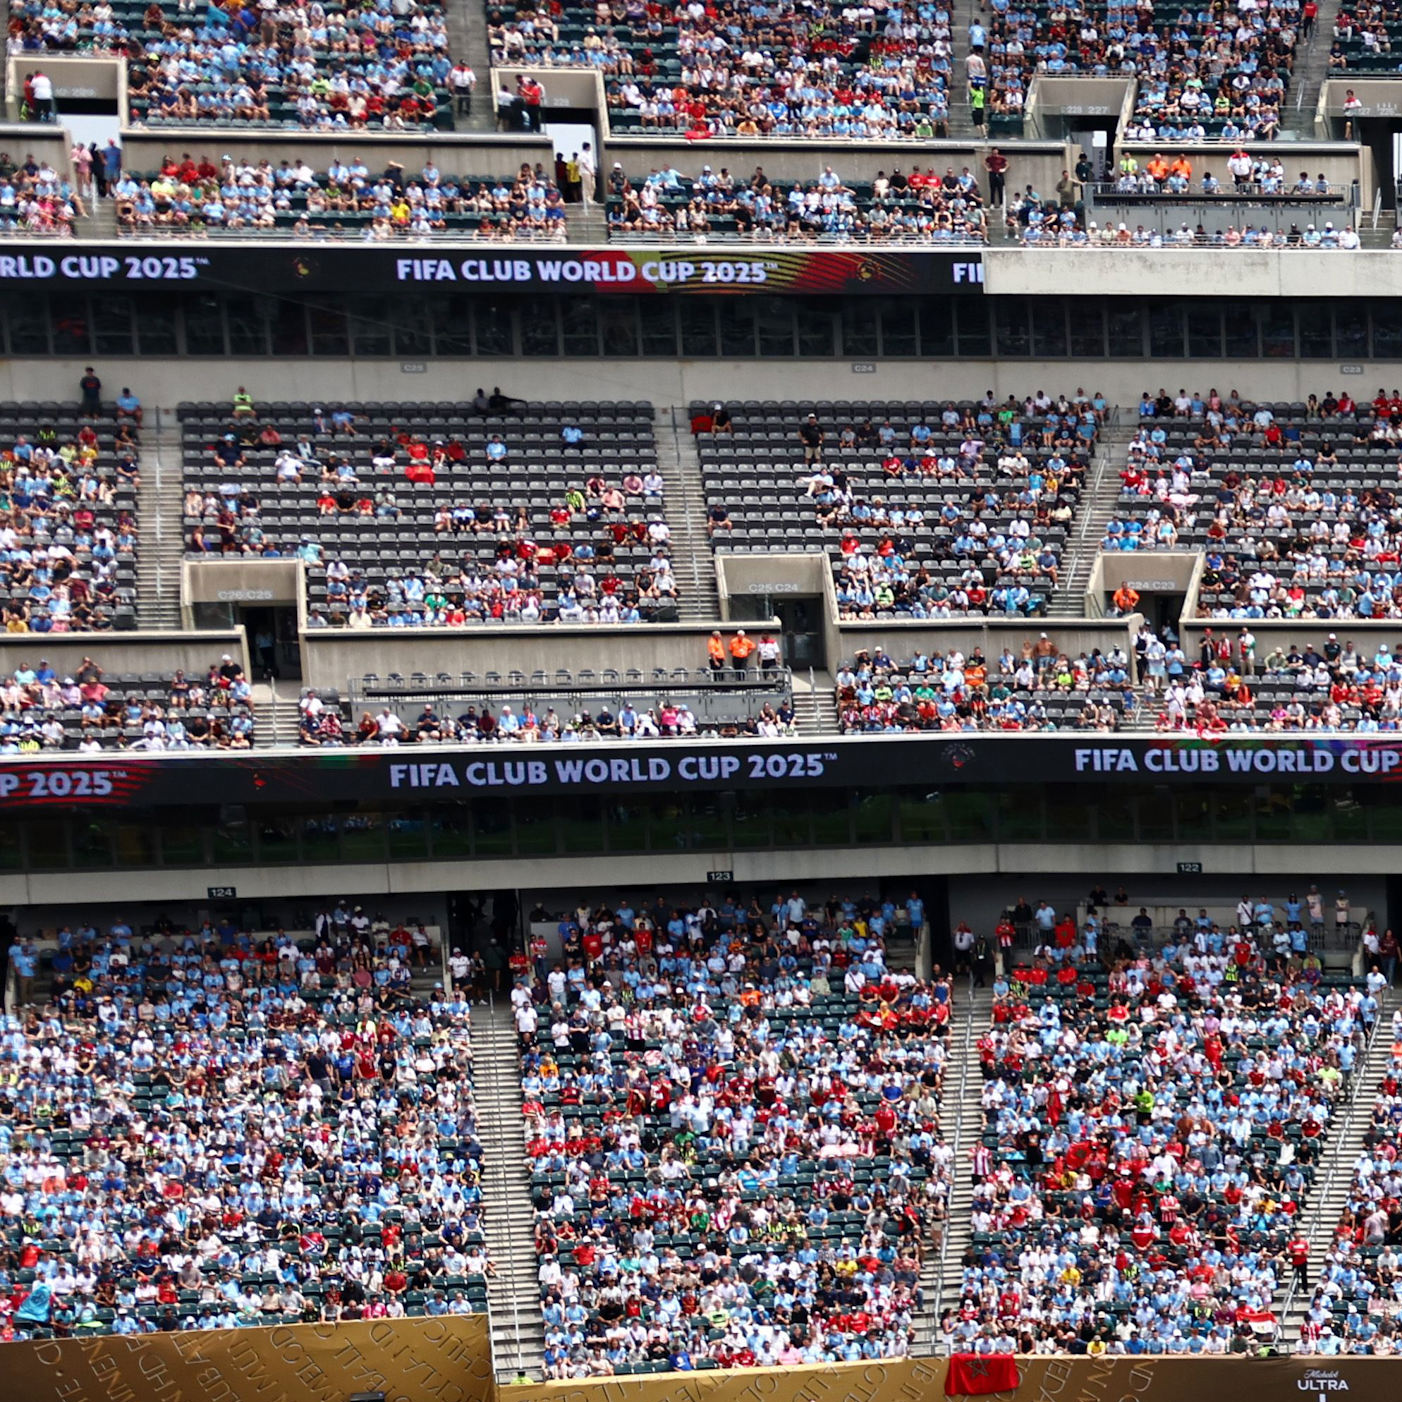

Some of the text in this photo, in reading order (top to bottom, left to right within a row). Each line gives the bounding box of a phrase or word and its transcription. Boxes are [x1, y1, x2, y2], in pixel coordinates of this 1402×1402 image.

[61, 257, 118, 278] CUP
[397, 259, 456, 281] FIFA
[462, 260, 532, 282] CLUB
[537, 260, 636, 282] WORLD
[642, 261, 695, 283] CUP
[1076, 749, 1138, 772] FIFA
[1145, 749, 1219, 772] CLUB
[1226, 749, 1334, 773] WORLD
[1341, 749, 1399, 773] CUP
[390, 764, 459, 787] FIFA
[467, 762, 547, 786] CLUB
[555, 758, 670, 783] WORLD
[679, 757, 740, 780] CUP
[708, 871, 732, 881] 123
[1178, 863, 1201, 873] 122
[210, 887, 233, 897] 124
[1297, 1379, 1349, 1391] ULTRA
